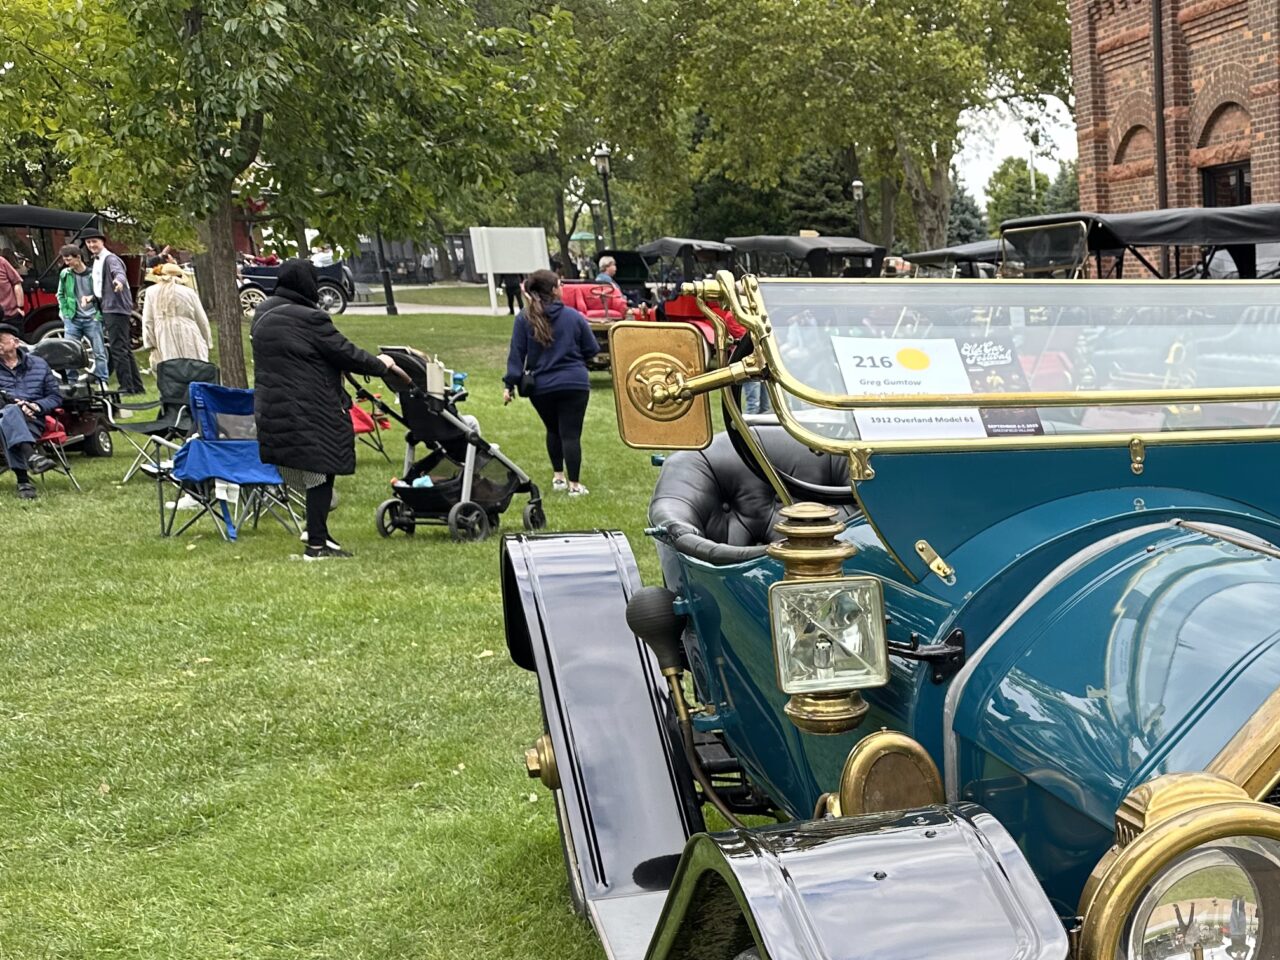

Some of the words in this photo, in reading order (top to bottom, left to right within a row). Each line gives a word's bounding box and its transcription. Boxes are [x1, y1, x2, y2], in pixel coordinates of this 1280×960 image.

[961, 343, 983, 356] Old
[983, 341, 1005, 354] Car
[852, 355, 893, 369] 216
[966, 349, 1012, 365] Festival
[859, 378, 881, 387] Greg
[882, 378, 922, 386] Gumtow
[870, 416, 892, 424] 1912
[893, 416, 933, 424] Overland
[935, 416, 963, 424] Model
